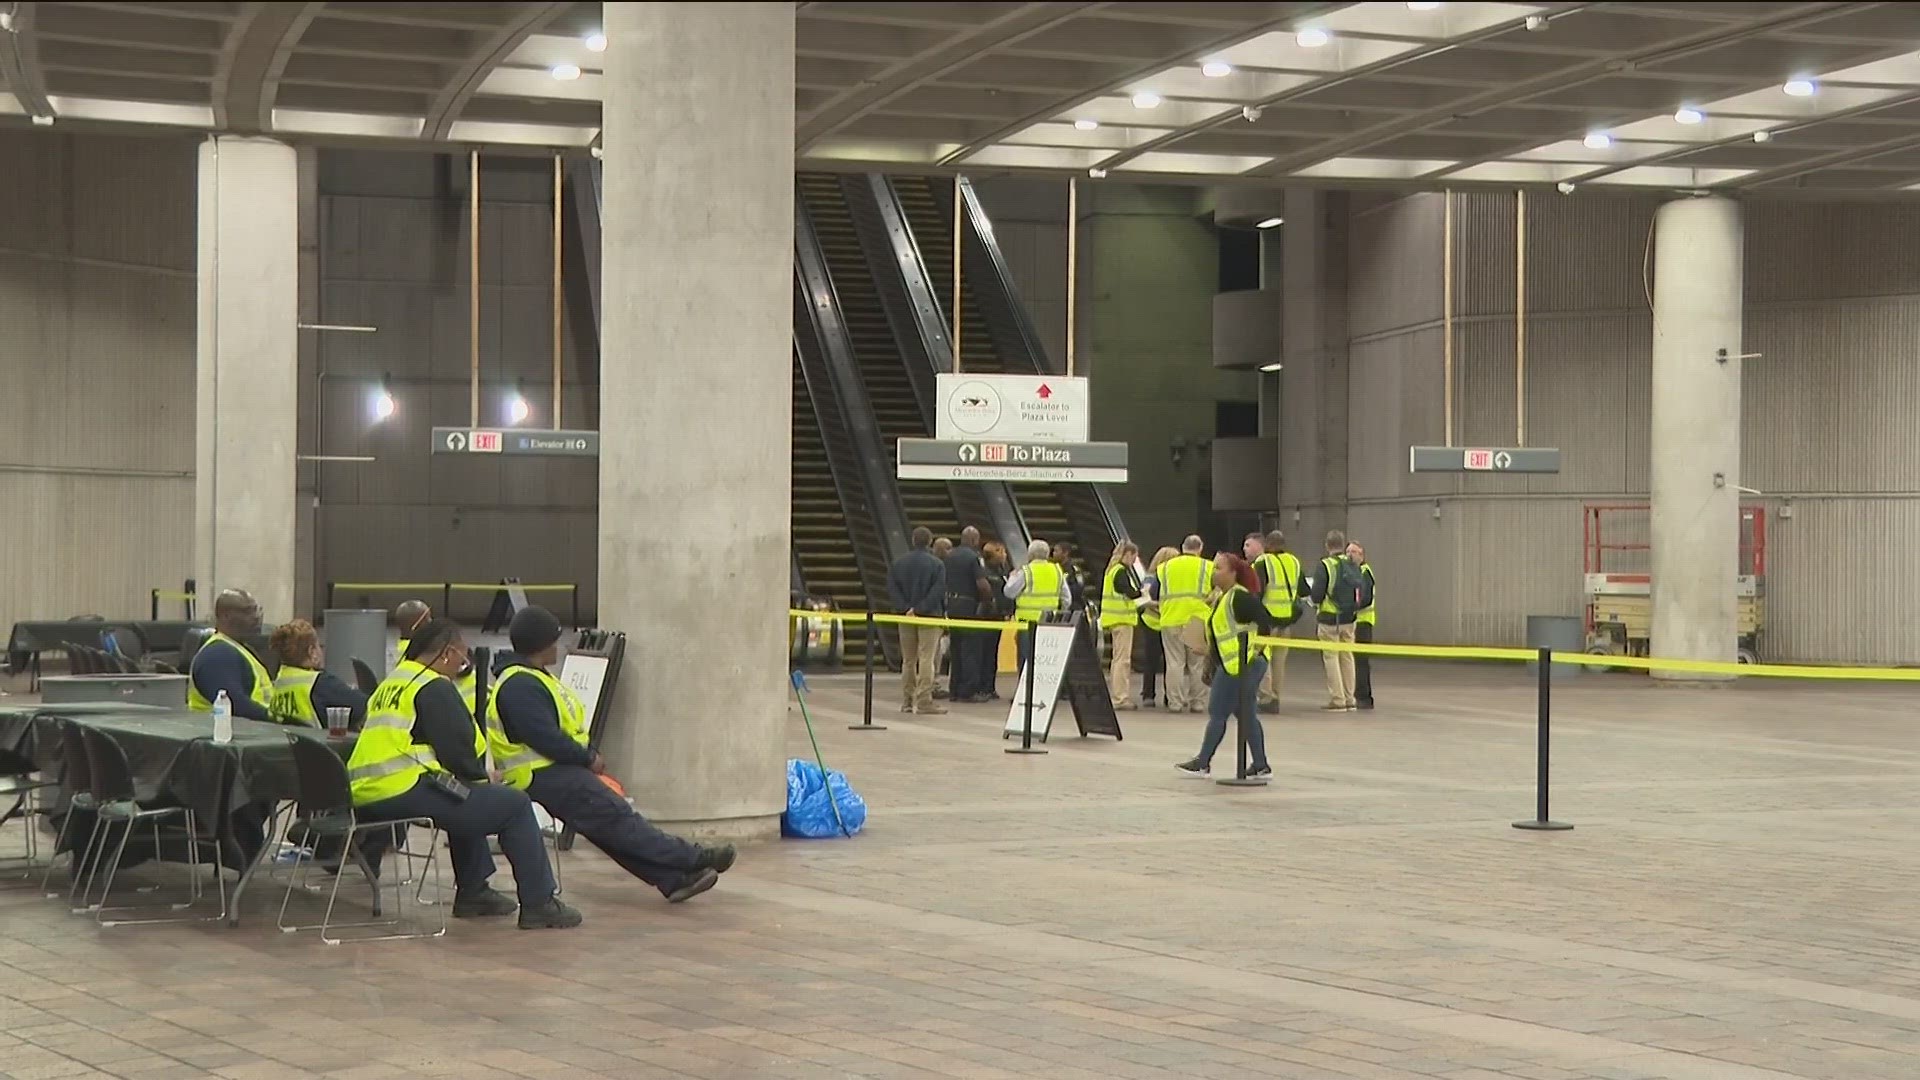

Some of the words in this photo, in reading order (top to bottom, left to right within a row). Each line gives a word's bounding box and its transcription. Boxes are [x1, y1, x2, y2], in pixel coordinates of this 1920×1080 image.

[1020, 401, 1060, 412] Escalator
[1061, 402, 1070, 412] to
[1021, 412, 1044, 422] Plaza
[1046, 412, 1068, 422] Level
[476, 434, 497, 449] EXIT
[530, 438, 564, 449] Elevator
[985, 445, 1003, 460] EXIT
[1009, 445, 1029, 460] To
[1031, 445, 1071, 462] Plaza
[1470, 452, 1489, 468] EXIT
[1030, 470, 1062, 479] Stadium
[571, 672, 589, 690] FULL
